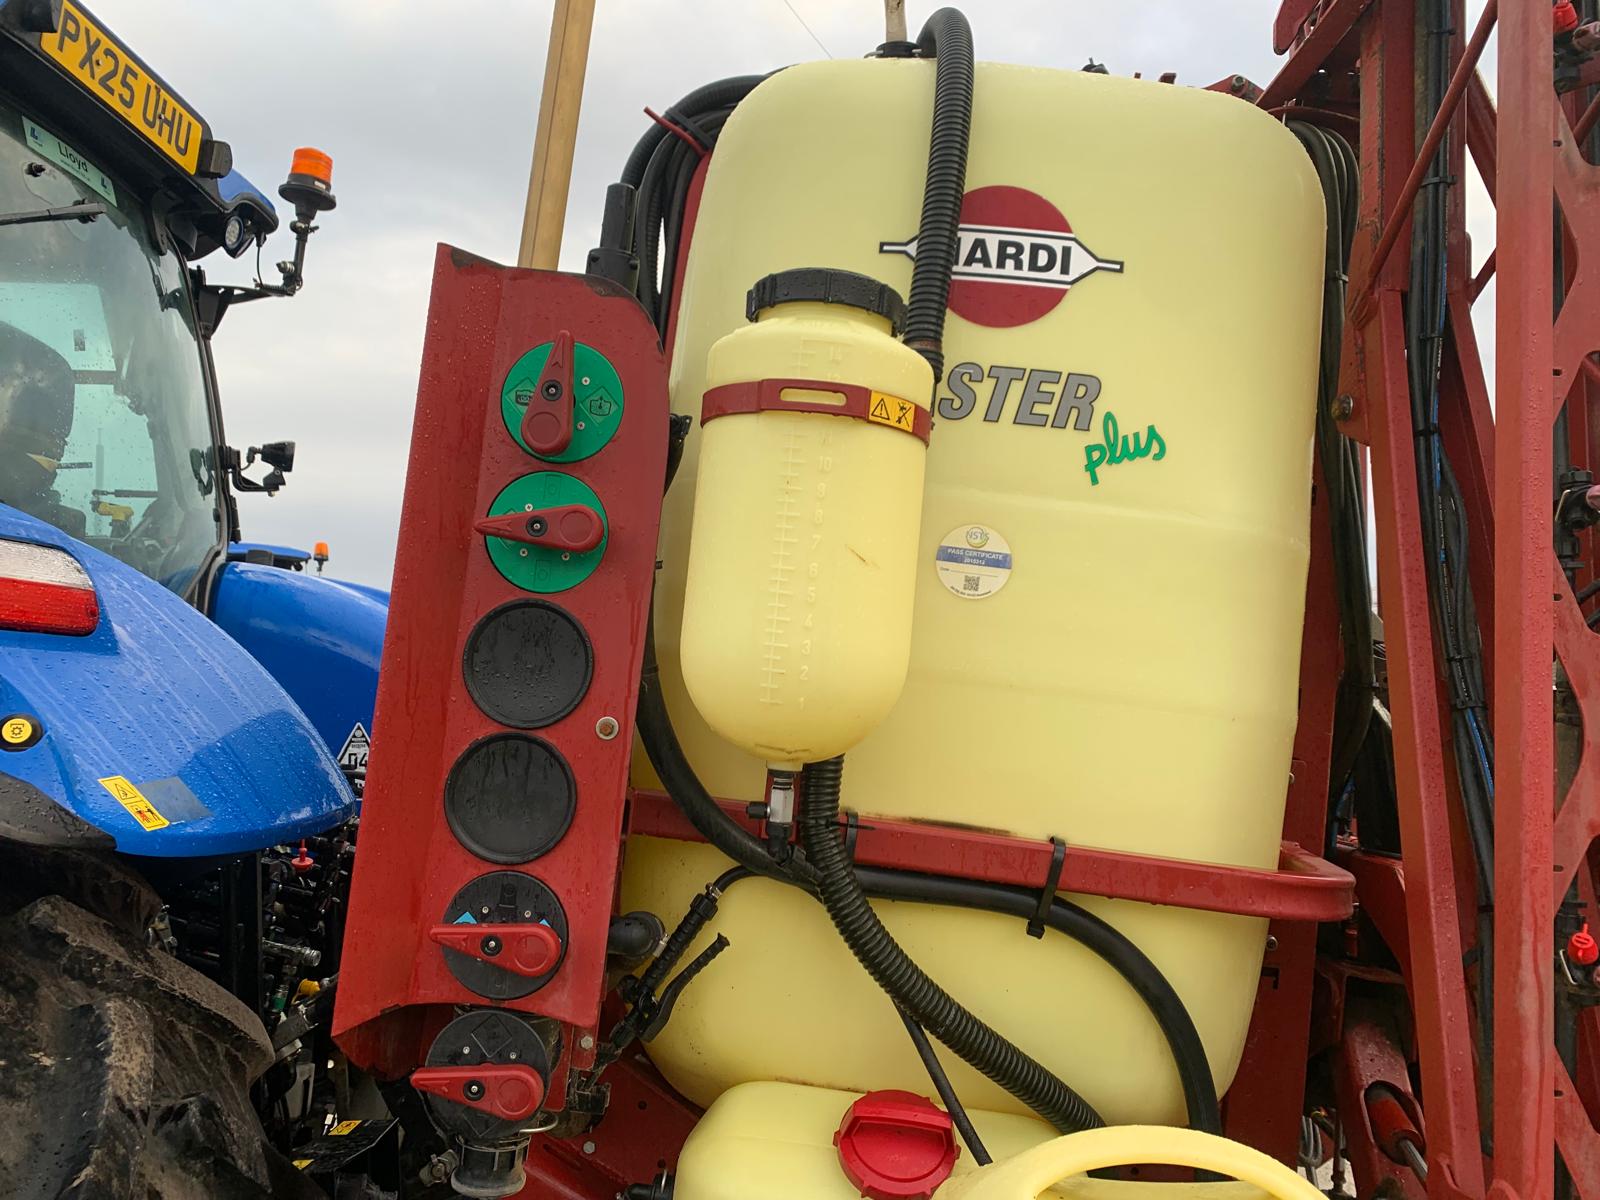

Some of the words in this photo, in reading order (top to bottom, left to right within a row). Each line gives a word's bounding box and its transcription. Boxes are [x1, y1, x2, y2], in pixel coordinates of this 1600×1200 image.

[57, 8, 139, 110] PX25
[142, 81, 192, 157] UHU
[57, 141, 88, 172] Lloyd
[953, 236, 1073, 276] ARDI
[934, 361, 1102, 432] STER
[818, 455, 832, 471] 10
[1084, 411, 1167, 486] plus
[947, 547, 964, 556] PASS
[964, 550, 1004, 561] CERTIFICATE
